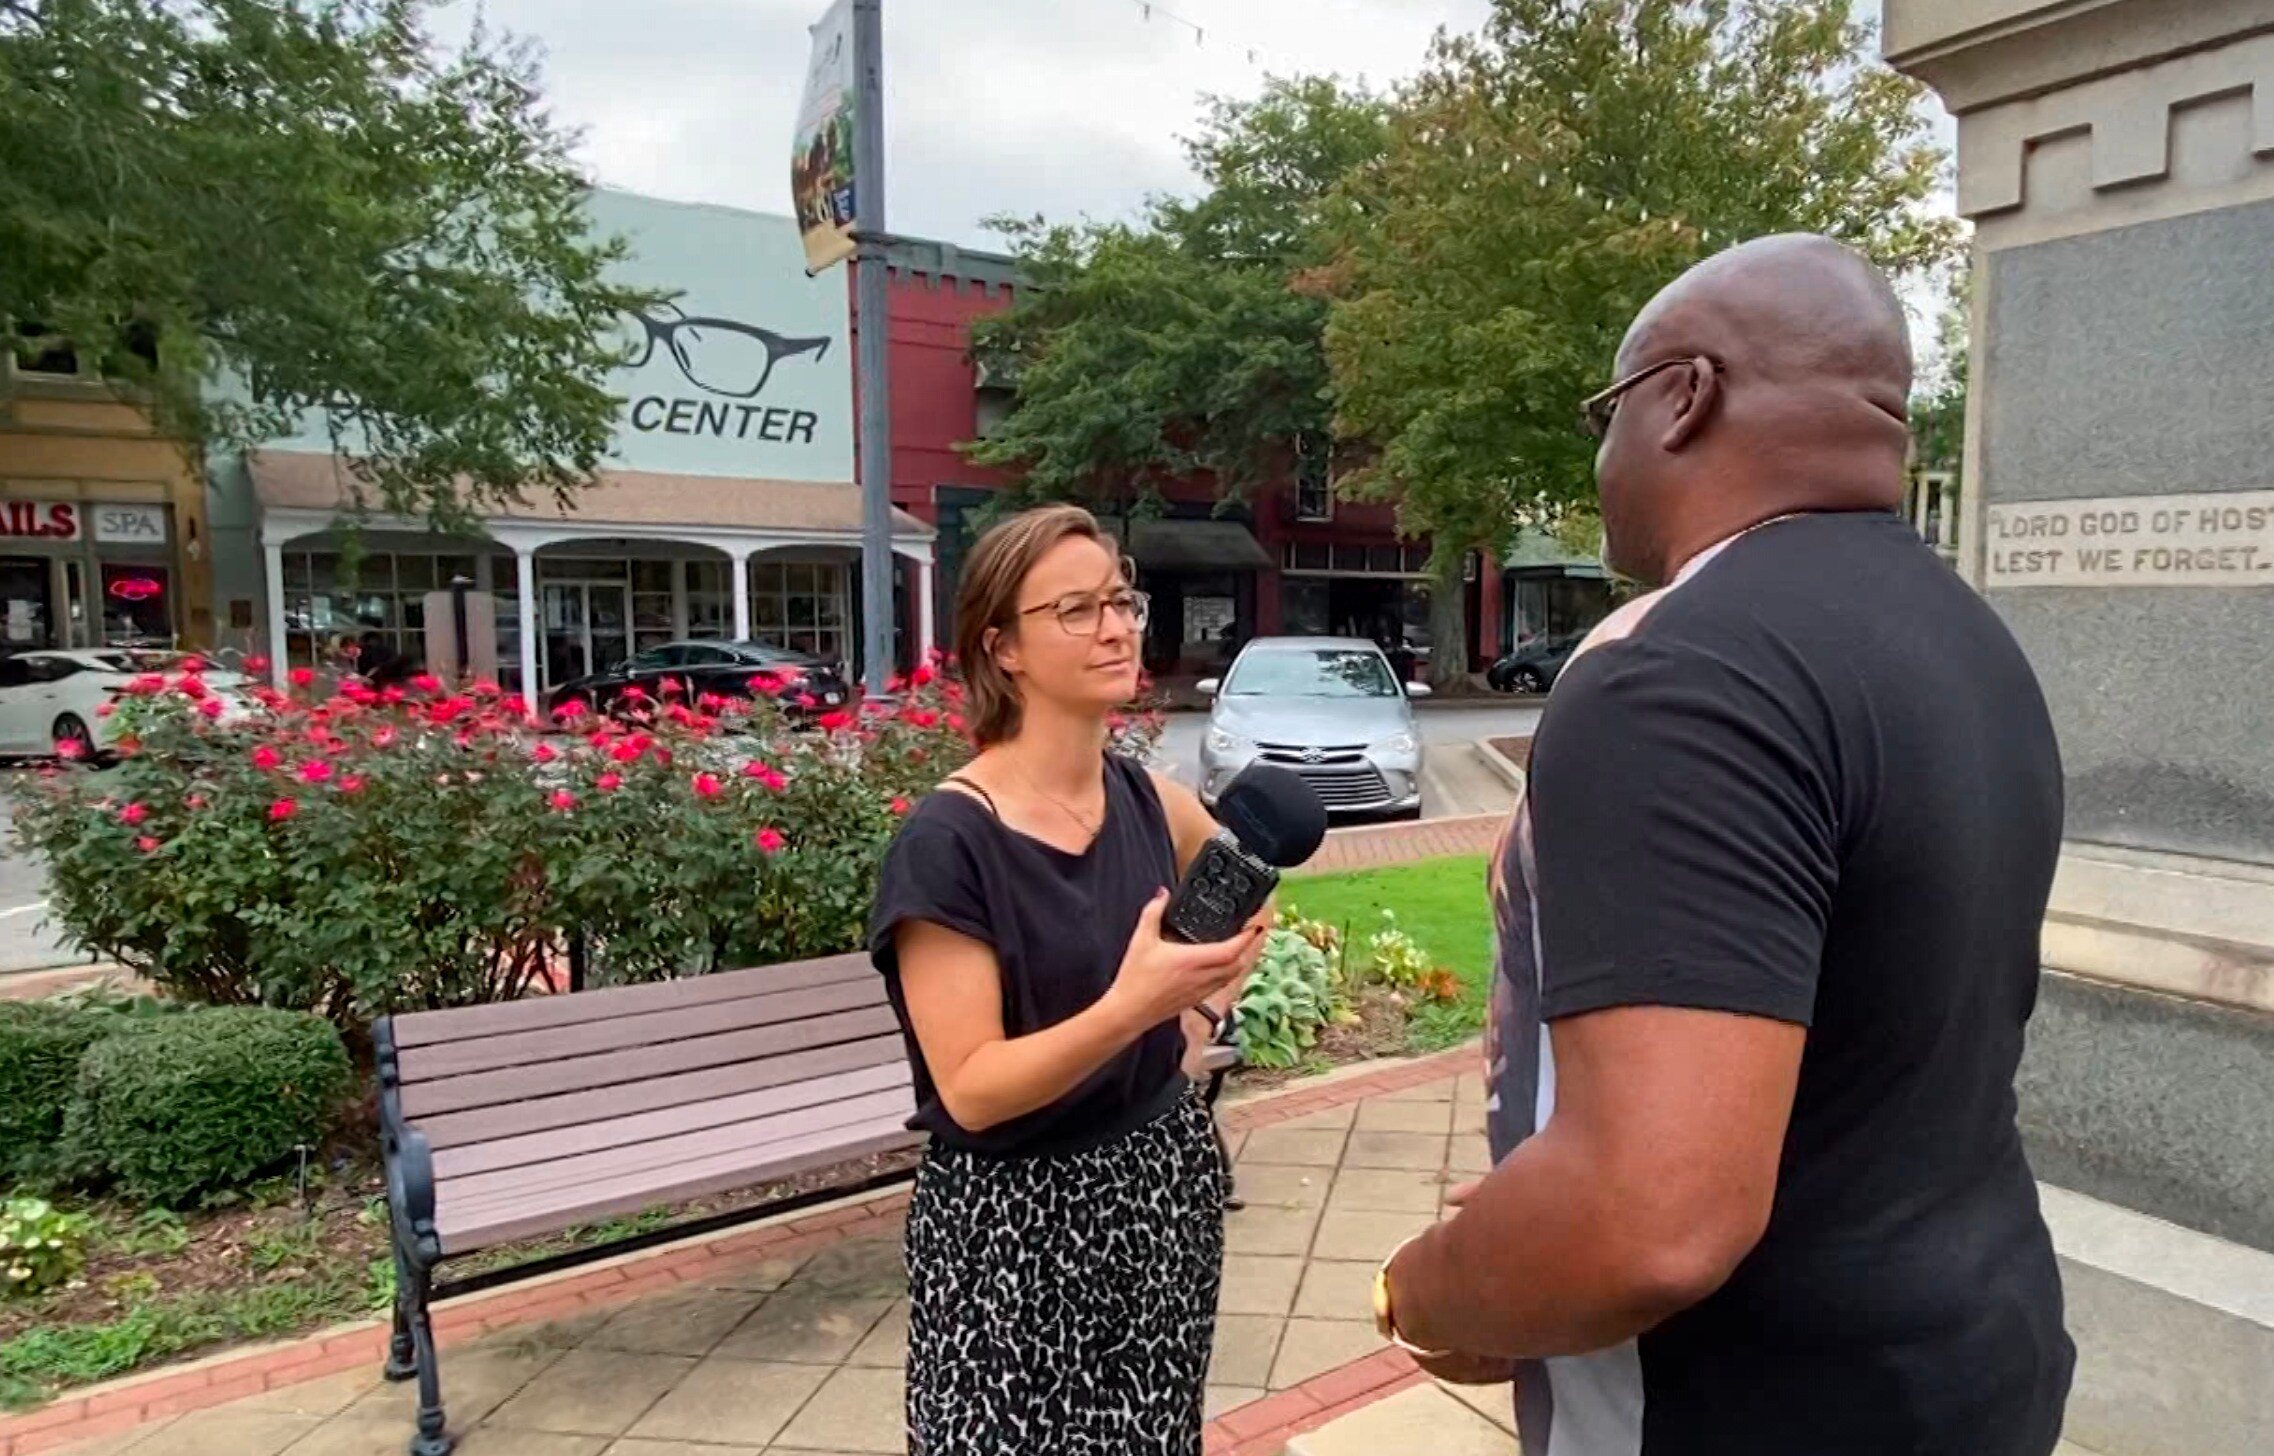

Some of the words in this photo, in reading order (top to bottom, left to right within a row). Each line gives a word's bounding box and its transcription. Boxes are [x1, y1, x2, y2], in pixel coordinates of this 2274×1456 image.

[631, 395, 818, 443] CENTER
[102, 512, 160, 536] SPA
[2079, 510, 2140, 536] GOD
[2151, 509, 2191, 533] OF
[1993, 550, 2064, 573] LEST
[2077, 549, 2124, 572] WE
